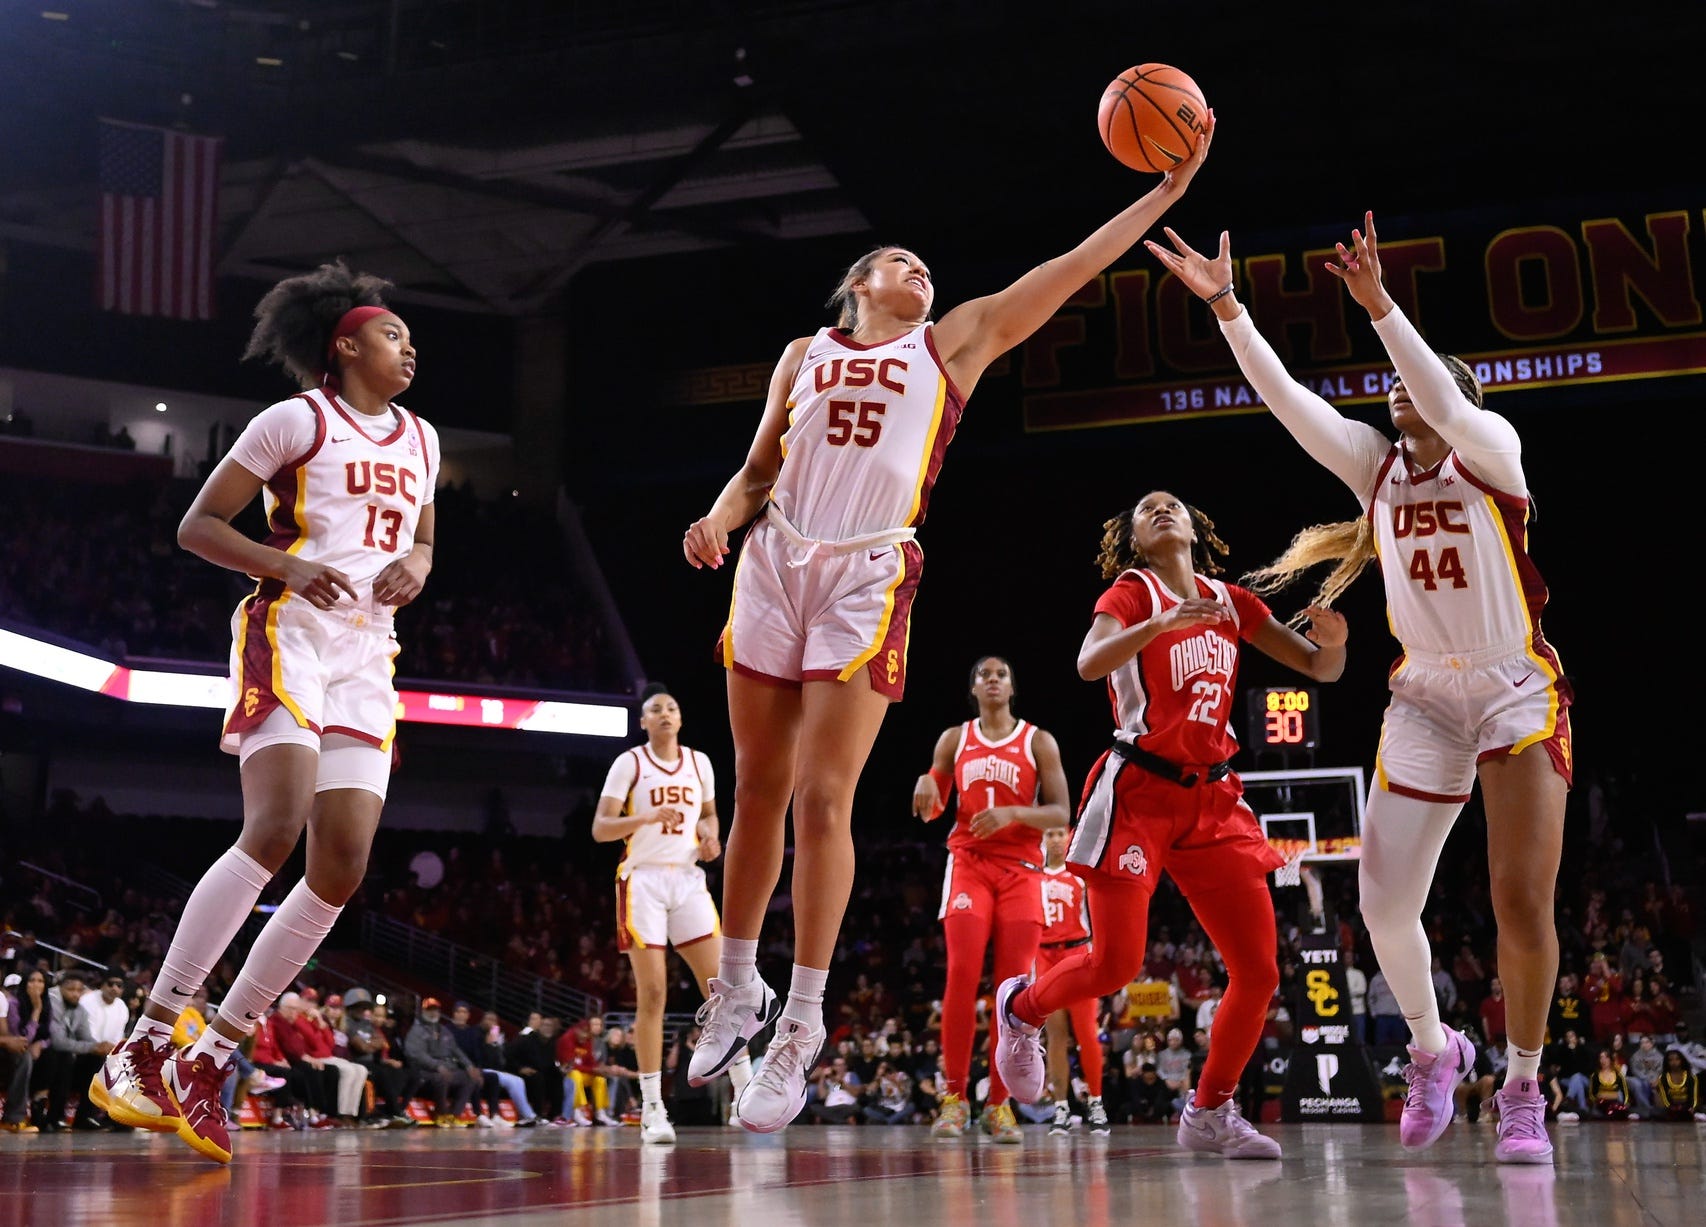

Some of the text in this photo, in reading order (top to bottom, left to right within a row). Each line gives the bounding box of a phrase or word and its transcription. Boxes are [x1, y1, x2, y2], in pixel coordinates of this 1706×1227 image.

[1484, 208, 1706, 341] ON
[814, 358, 909, 396] USC
[1160, 388, 1206, 412] 136
[827, 400, 887, 448] 55
[345, 460, 417, 507] USC
[363, 504, 404, 554] 13
[1394, 501, 1470, 539] USC
[1409, 546, 1468, 591] 44
[1187, 680, 1222, 727] 22
[1266, 691, 1309, 711] 8:00
[1266, 710, 1303, 743] 30
[650, 786, 695, 807] USC
[1300, 950, 1338, 964] YETI
